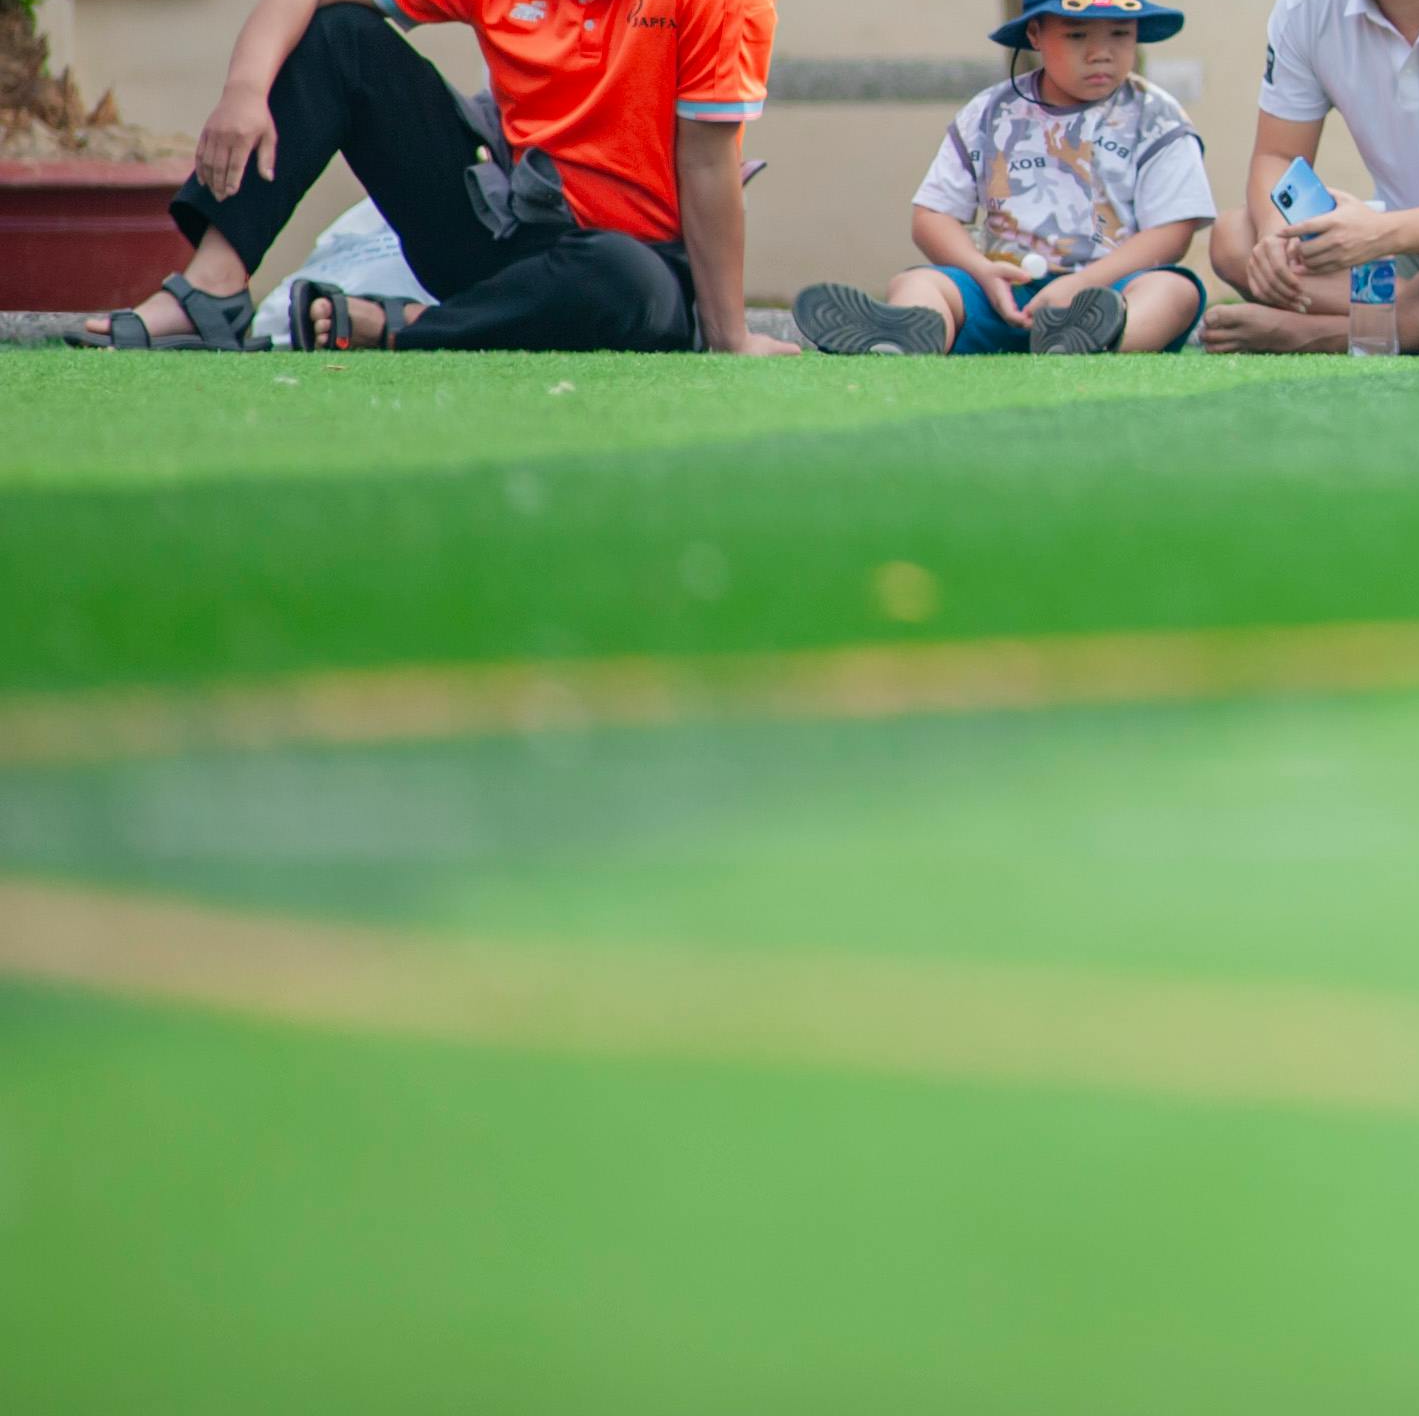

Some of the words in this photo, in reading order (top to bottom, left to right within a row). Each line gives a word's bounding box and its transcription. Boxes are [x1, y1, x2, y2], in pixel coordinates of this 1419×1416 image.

[632, 16, 678, 29] JAPFA
[1092, 135, 1130, 159] BOY
[1008, 156, 1047, 173] BOY
